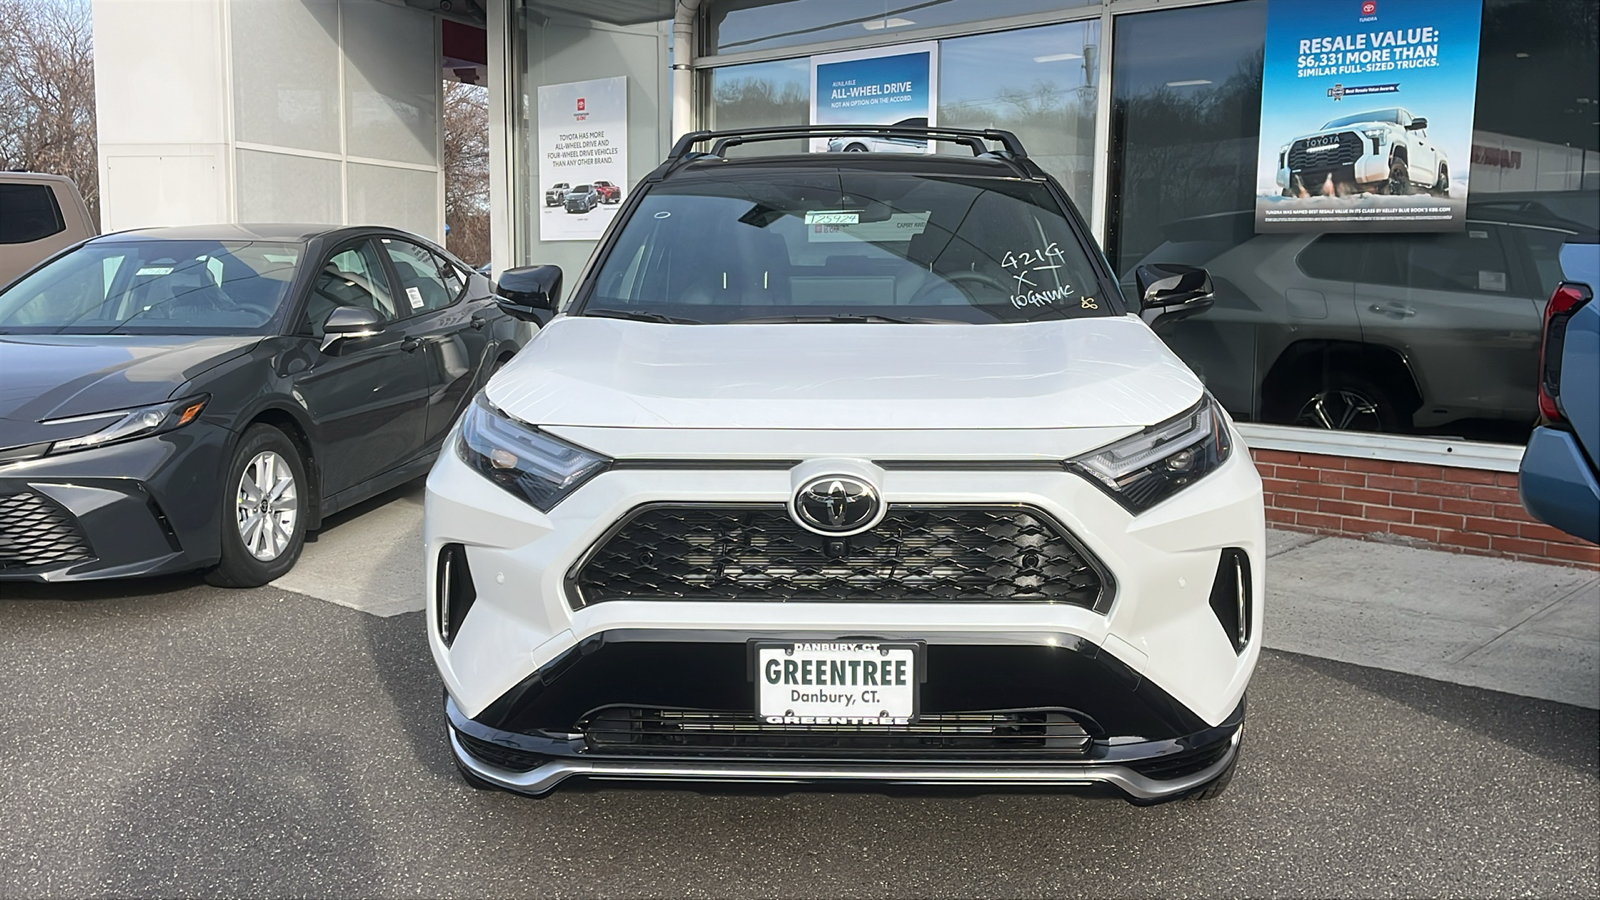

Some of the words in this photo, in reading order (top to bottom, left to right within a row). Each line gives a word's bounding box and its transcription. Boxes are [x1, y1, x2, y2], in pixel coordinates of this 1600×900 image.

[1300, 34, 1366, 54] RESALE
[1370, 27, 1439, 48] VALUE:
[1298, 52, 1342, 68] $6,331
[1346, 49, 1390, 64] MORE
[1393, 44, 1437, 60] THAN
[1298, 67, 1337, 77] SIMILAR
[1339, 62, 1394, 74] FULL-SIZED
[1397, 58, 1439, 69] TRUCKS.
[831, 85, 882, 99] ALL-WHEEL
[884, 82, 912, 94] DRIVE
[555, 142, 582, 150] ALL-WHEEL
[1306, 136, 1340, 147] TOYOTA
[548, 150, 578, 159] FOUR-WHEEL
[594, 148, 618, 156] VEHICLES
[794, 643, 859, 652] DANBURY,
[765, 659, 907, 686] GREENTREE
[791, 689, 856, 707] Danbury,
[861, 690, 880, 703] CT.
[766, 717, 909, 725] GREENTREE
